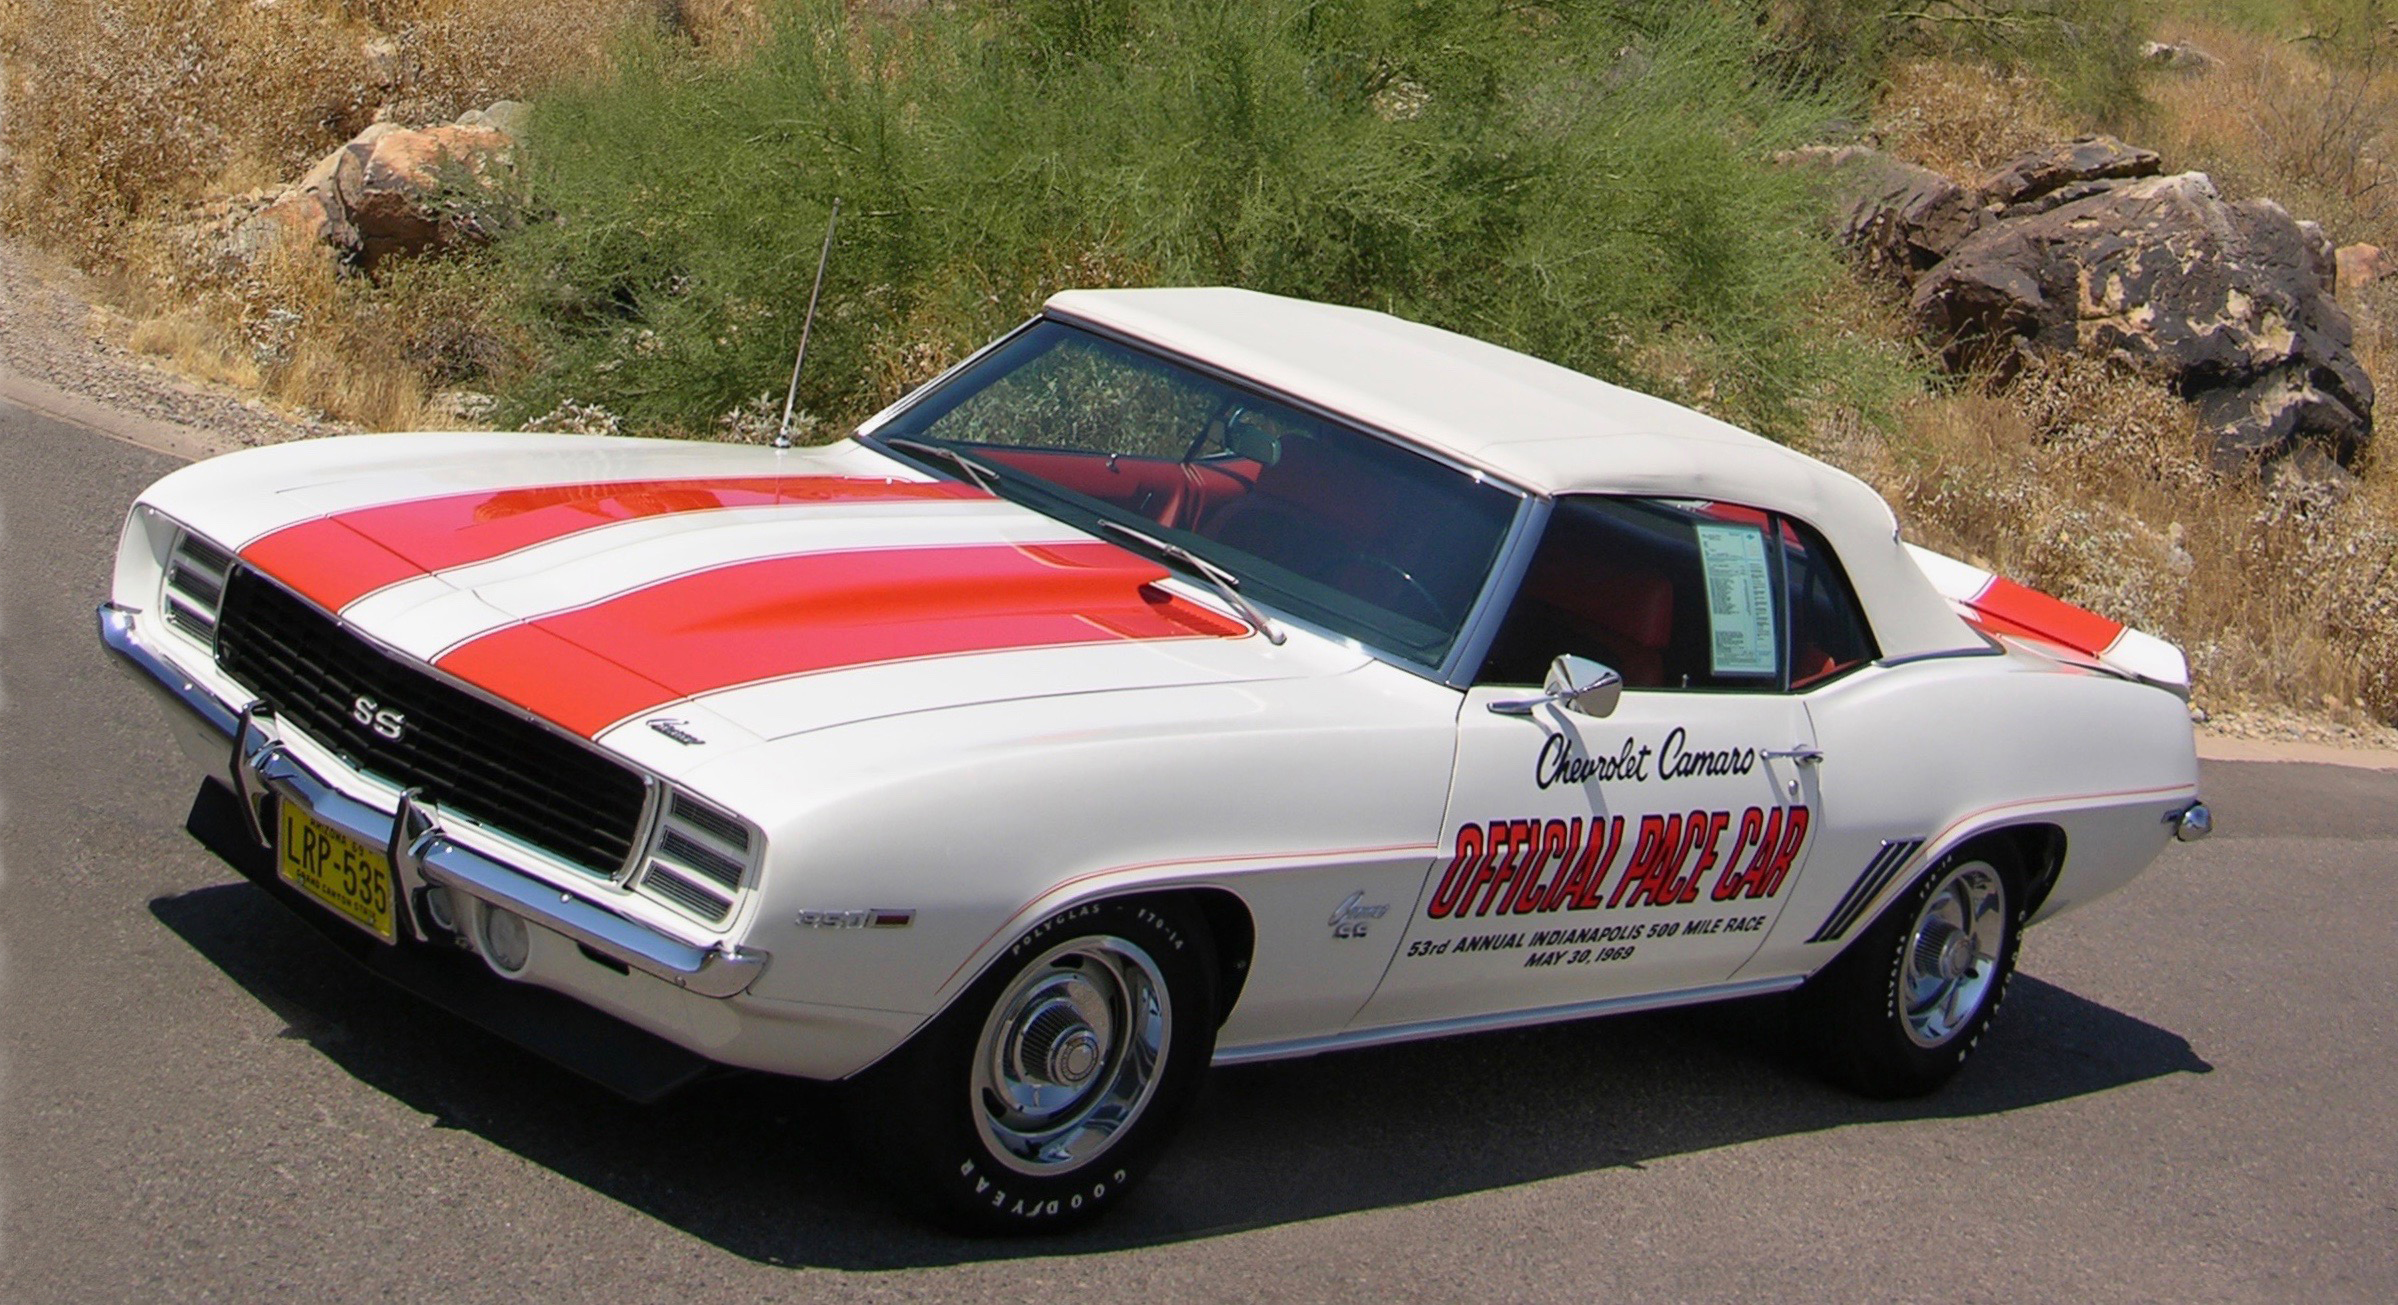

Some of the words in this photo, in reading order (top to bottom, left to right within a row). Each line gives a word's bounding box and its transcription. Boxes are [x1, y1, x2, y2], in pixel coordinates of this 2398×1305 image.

[353, 696, 405, 739] SS
[1535, 732, 1652, 790] Chevrolet
[1658, 727, 1755, 780] Camaro
[287, 816, 387, 914] LRP-535
[1427, 814, 1625, 919] OFFICIAL
[1605, 809, 1731, 911] PACE
[1710, 805, 1810, 902] CAR
[1012, 903, 1100, 956] POLYGLAS
[1407, 938, 1452, 957] 53rd
[1452, 931, 1524, 954] ANNUAL
[1527, 923, 1645, 947] INDIANAPOLIS
[1648, 923, 1680, 939] 500
[1682, 918, 1724, 936] MILE
[1722, 915, 1767, 934] RACE
[1524, 951, 1565, 968] MAY
[1591, 945, 1636, 961] 1969
